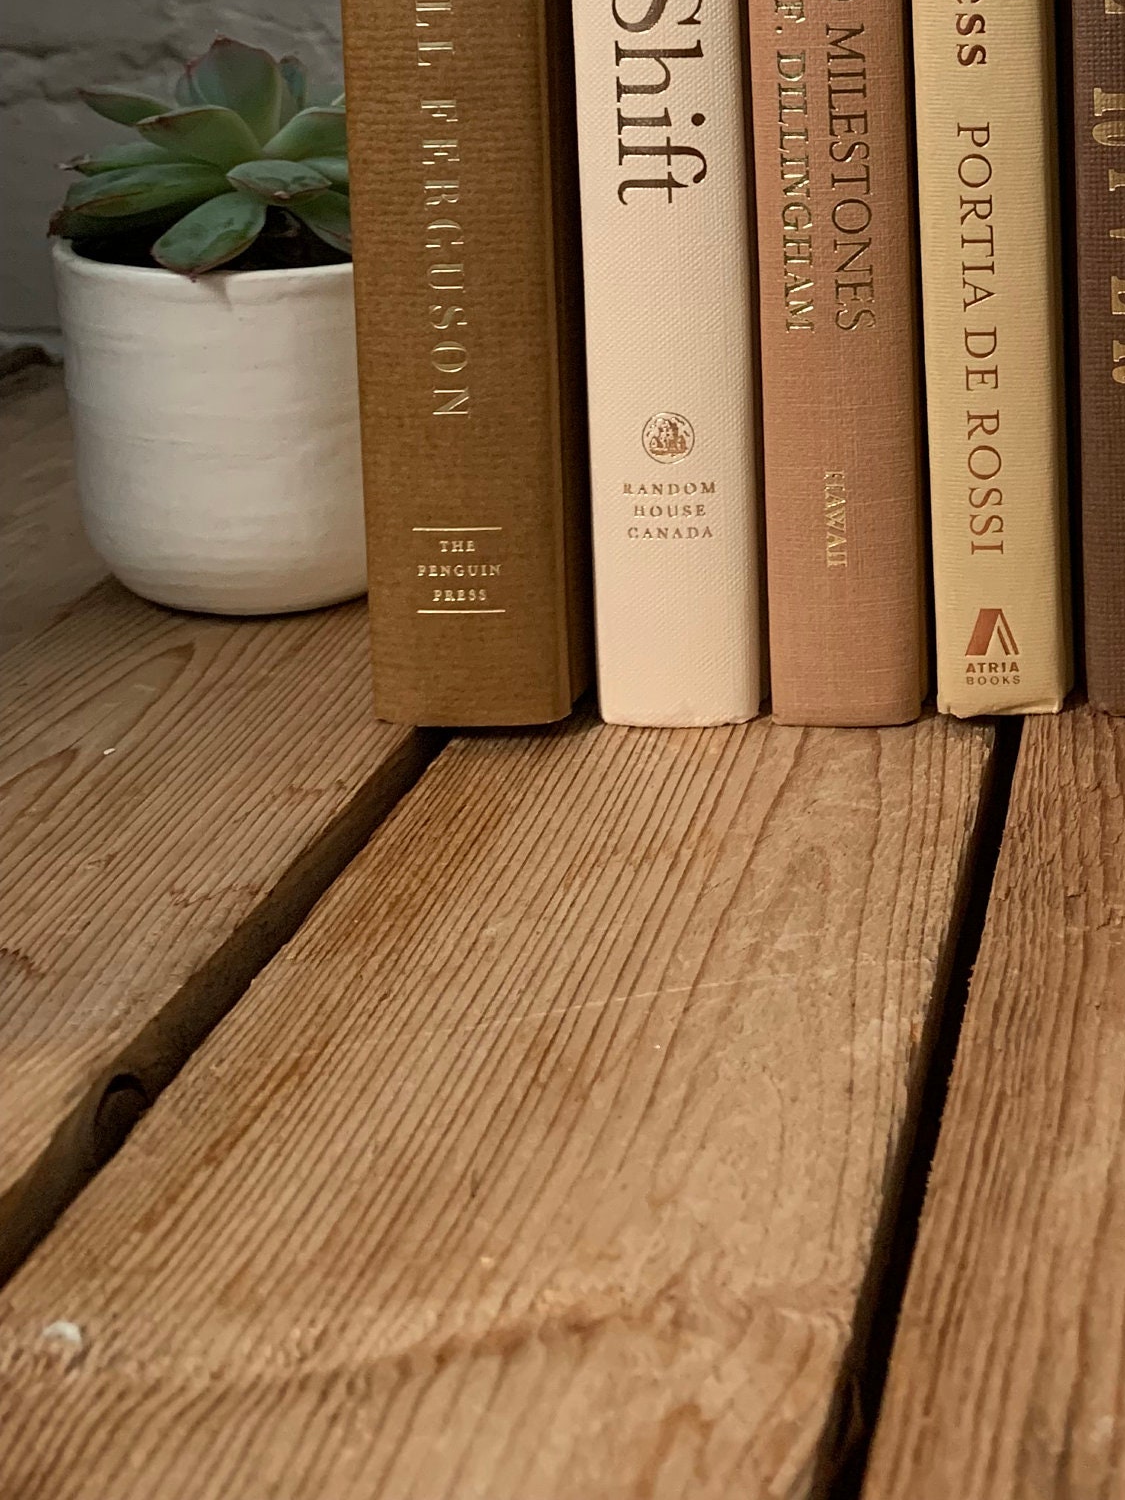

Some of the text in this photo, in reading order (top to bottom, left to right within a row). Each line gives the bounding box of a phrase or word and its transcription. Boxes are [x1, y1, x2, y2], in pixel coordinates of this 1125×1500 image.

[825, 23, 876, 332] MILESTONES
[776, 50, 815, 334] DILLINGHAM
[419, 99, 470, 419] FERGUSON
[957, 121, 1005, 556] PORTIA DE ROSSI
[623, 481, 717, 496] RANDOM
[633, 504, 707, 518] HOUSE
[627, 525, 714, 540] CANADA
[438, 539, 477, 553] THE
[417, 563, 502, 578] PENGUIN
[432, 587, 488, 602] PRESS
[966, 661, 1020, 674] ATRIA
[966, 675, 1021, 686] BOOKS
